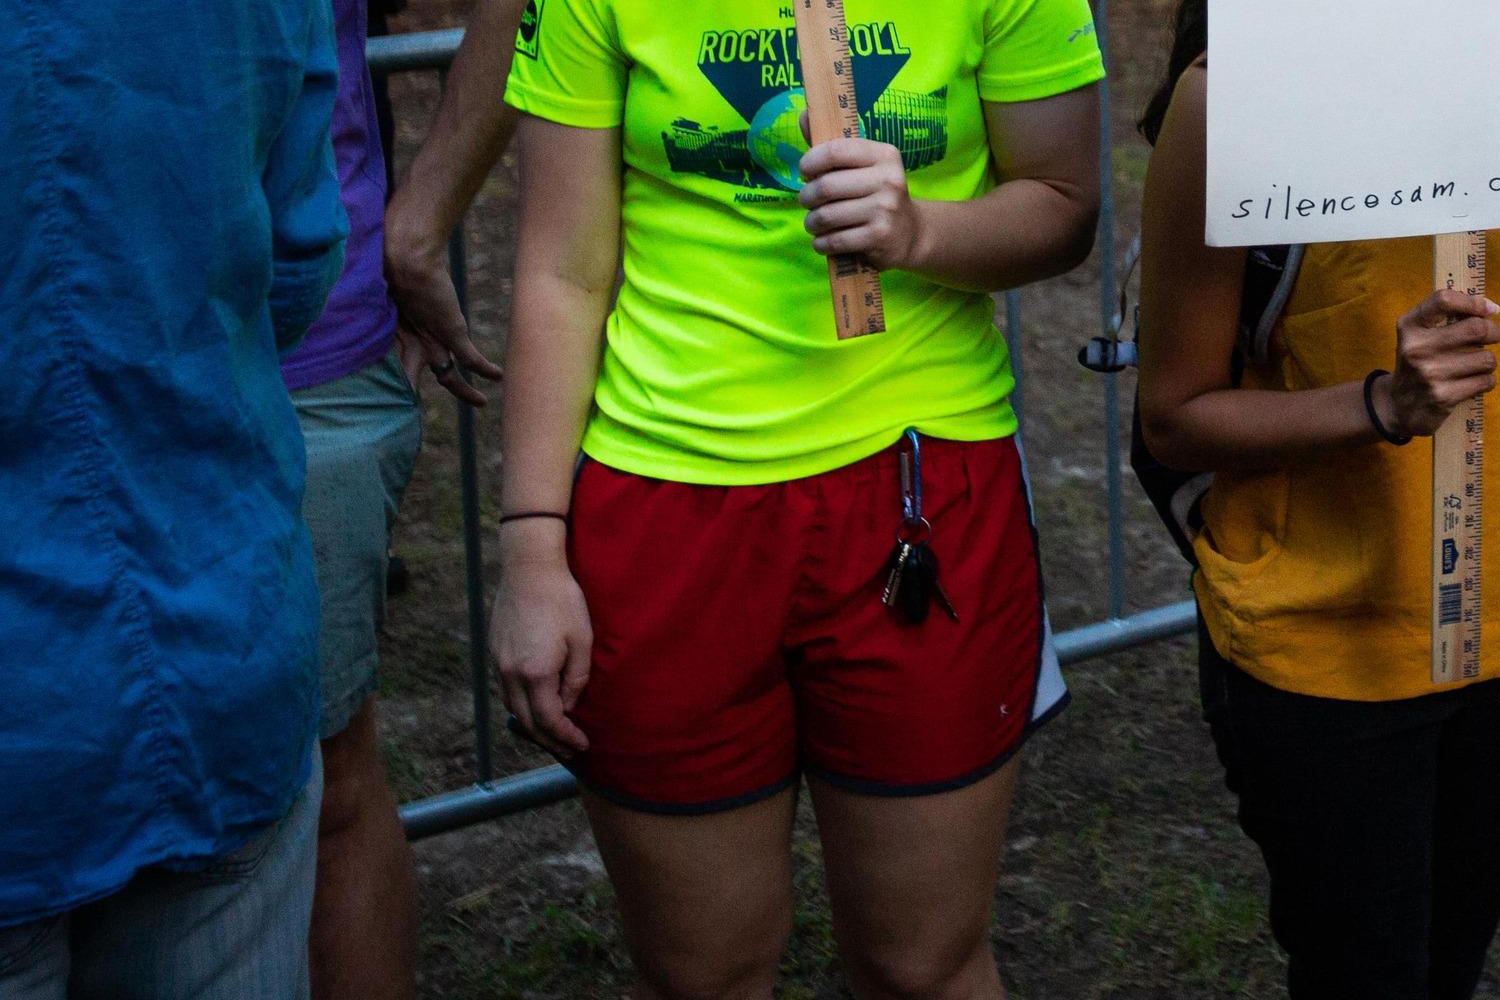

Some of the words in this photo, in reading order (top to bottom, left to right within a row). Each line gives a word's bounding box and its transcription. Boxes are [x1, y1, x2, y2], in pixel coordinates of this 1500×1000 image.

[698, 29, 782, 65] ROCK
[848, 22, 911, 57] OLL
[829, 27, 839, 42] 27
[838, 94, 847, 109] 29
